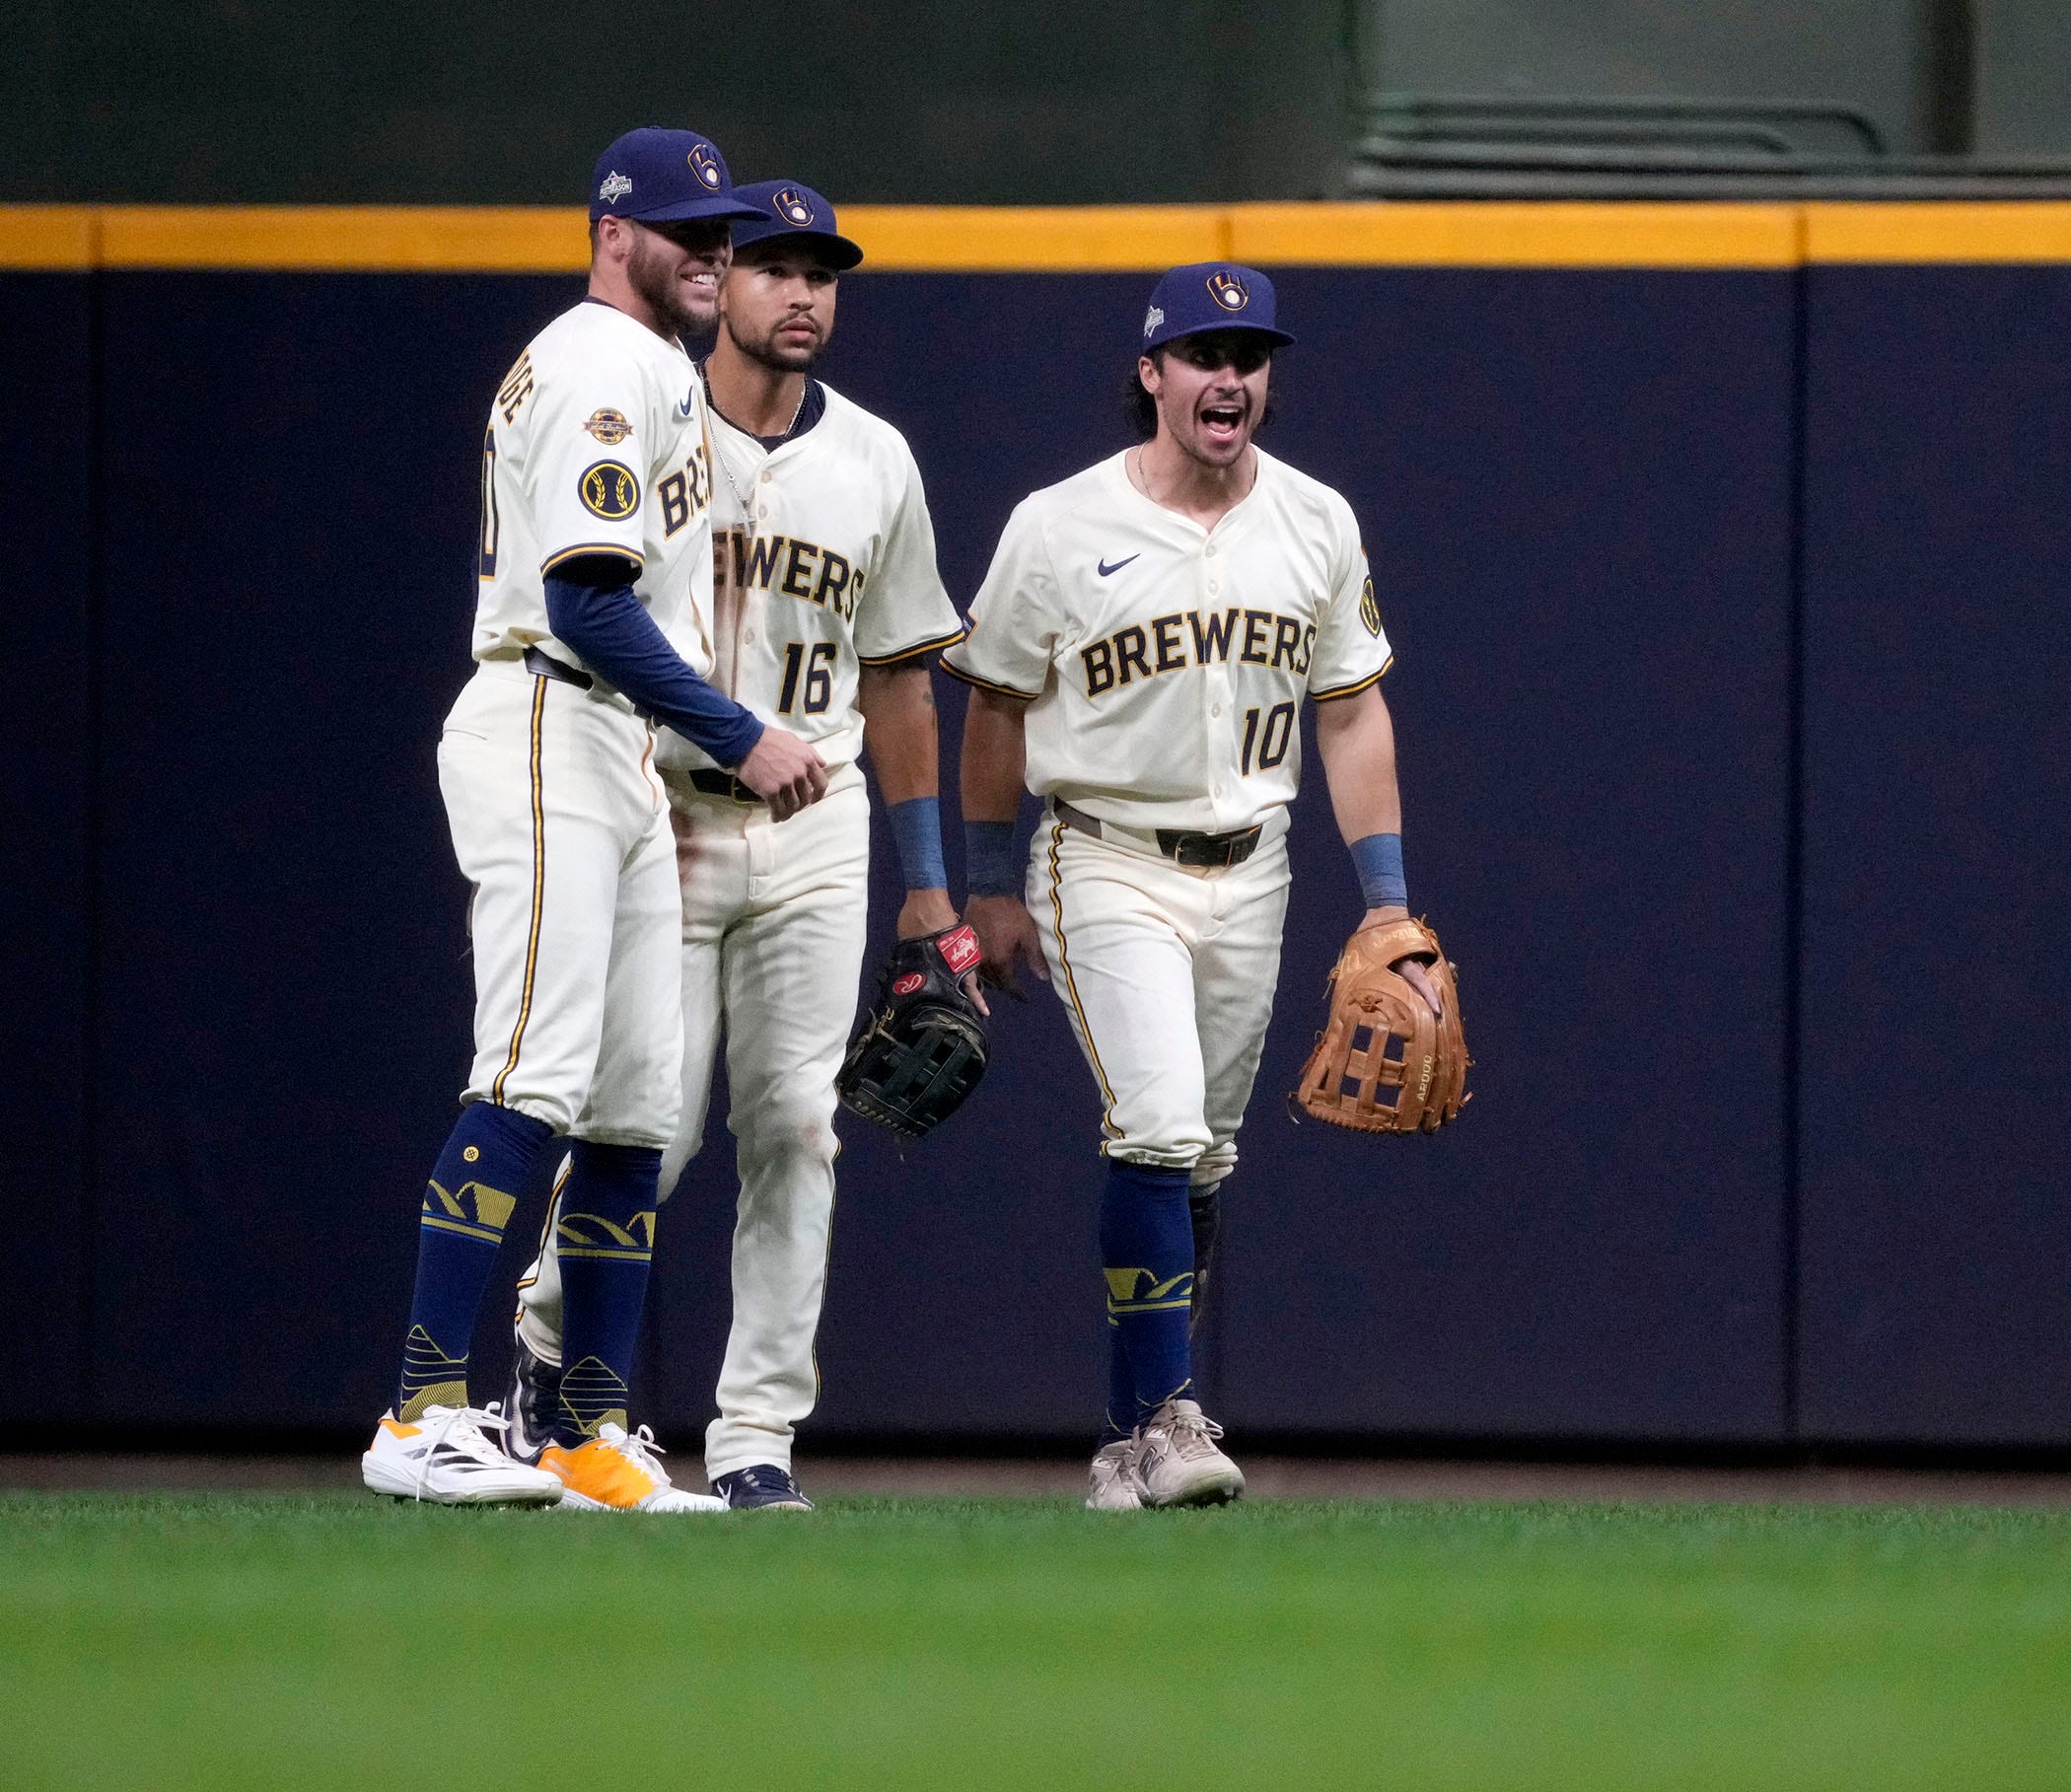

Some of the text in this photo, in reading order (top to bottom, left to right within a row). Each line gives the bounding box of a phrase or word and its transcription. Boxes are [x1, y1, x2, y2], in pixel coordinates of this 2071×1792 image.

[778, 641, 837, 717] 16
[1081, 607, 1318, 700] BREWERS
[1240, 700, 1296, 779] 10
